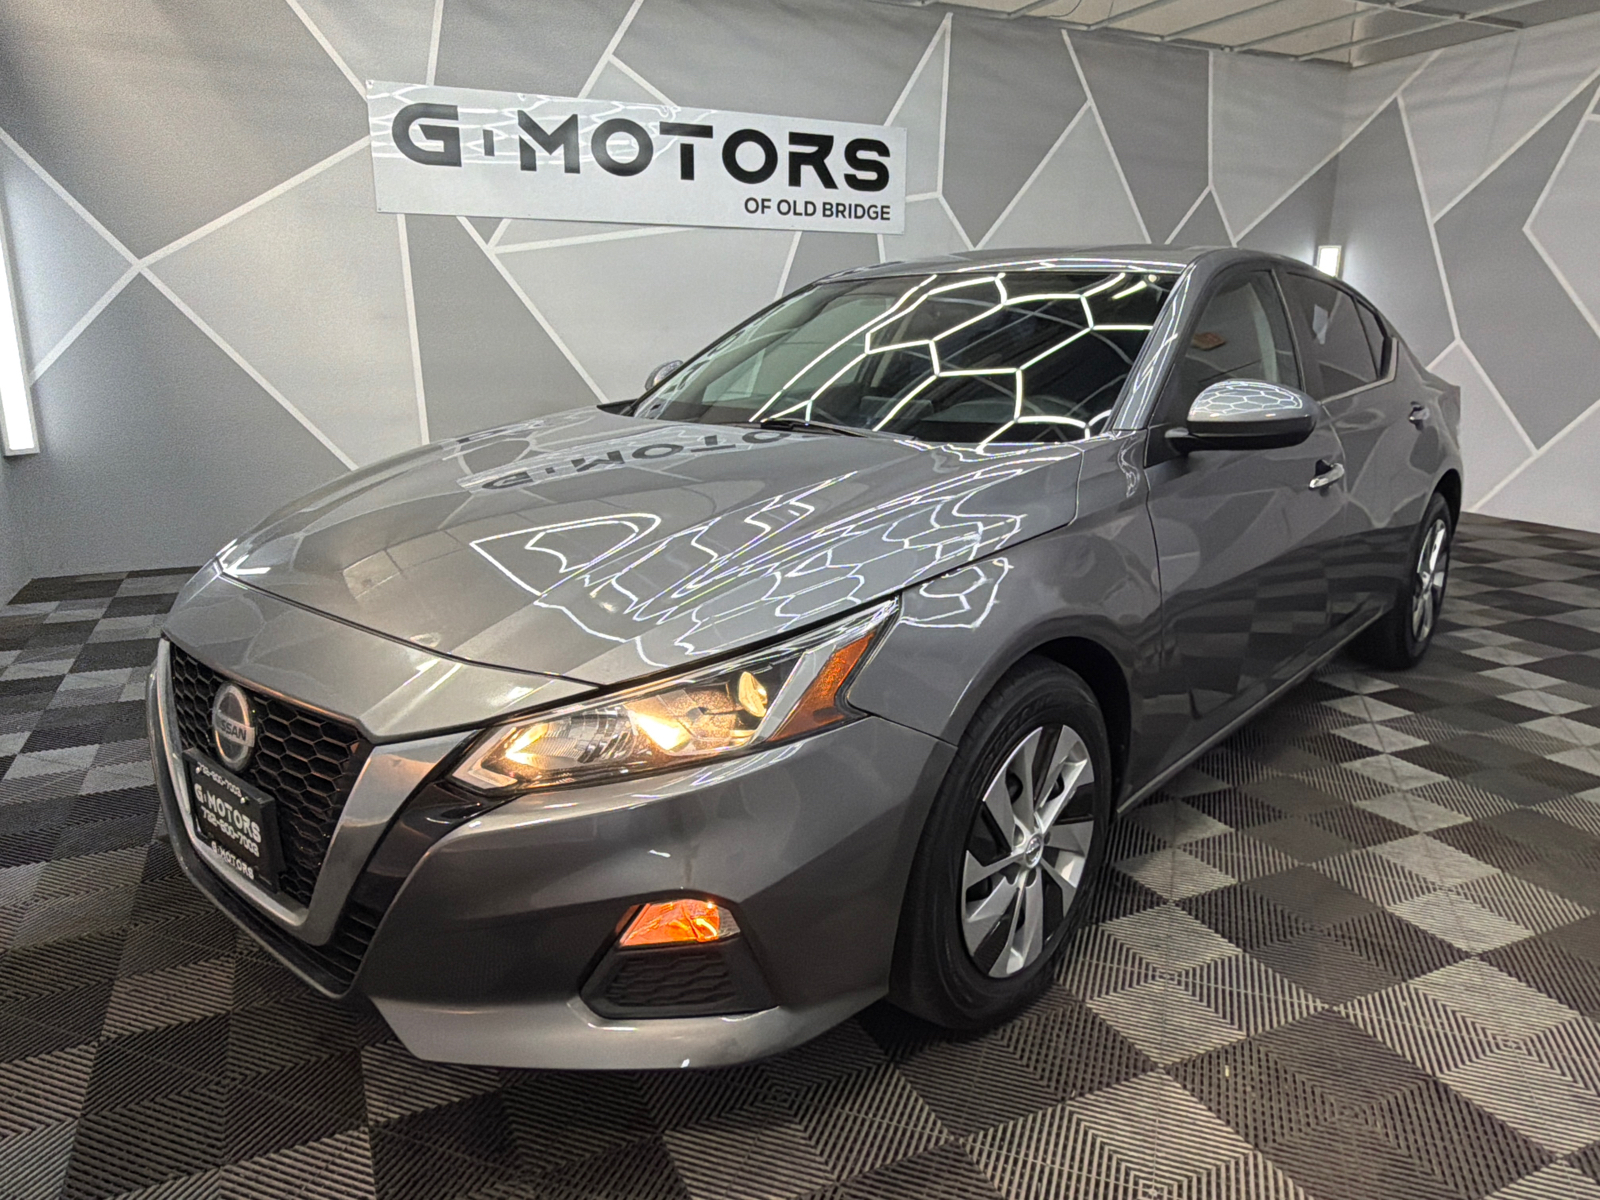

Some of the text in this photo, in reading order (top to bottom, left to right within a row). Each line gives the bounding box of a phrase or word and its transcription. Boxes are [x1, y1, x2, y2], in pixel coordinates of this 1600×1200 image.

[744, 197, 891, 221] OF OLD BRIDGE
